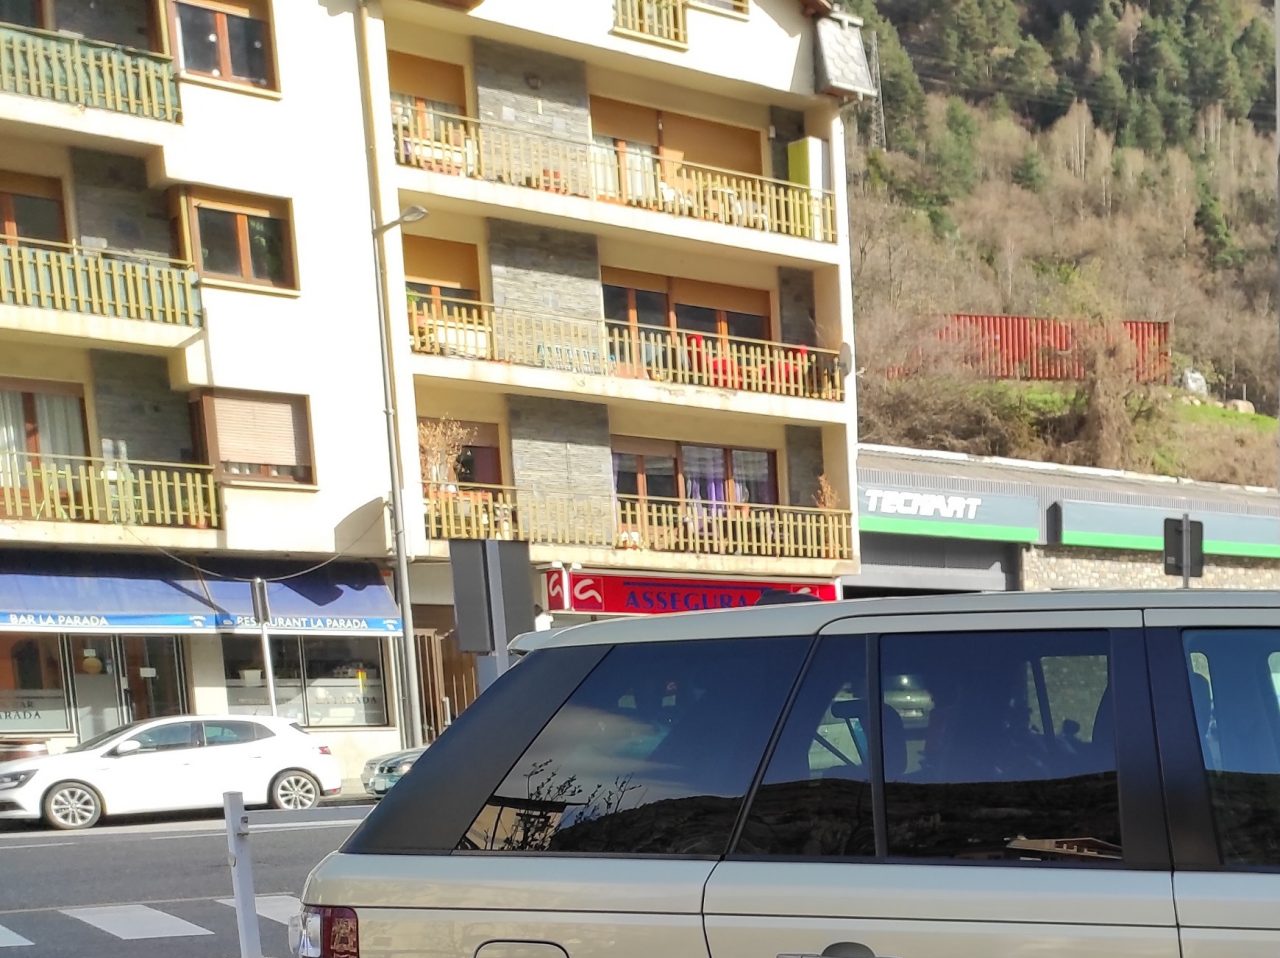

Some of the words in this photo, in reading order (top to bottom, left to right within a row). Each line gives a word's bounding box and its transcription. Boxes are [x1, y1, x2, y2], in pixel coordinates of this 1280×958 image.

[9, 614, 36, 625] BAR
[39, 615, 56, 625] LA
[58, 616, 109, 626] PARADA
[309, 618, 325, 629] LA
[326, 619, 368, 629] PARADA
